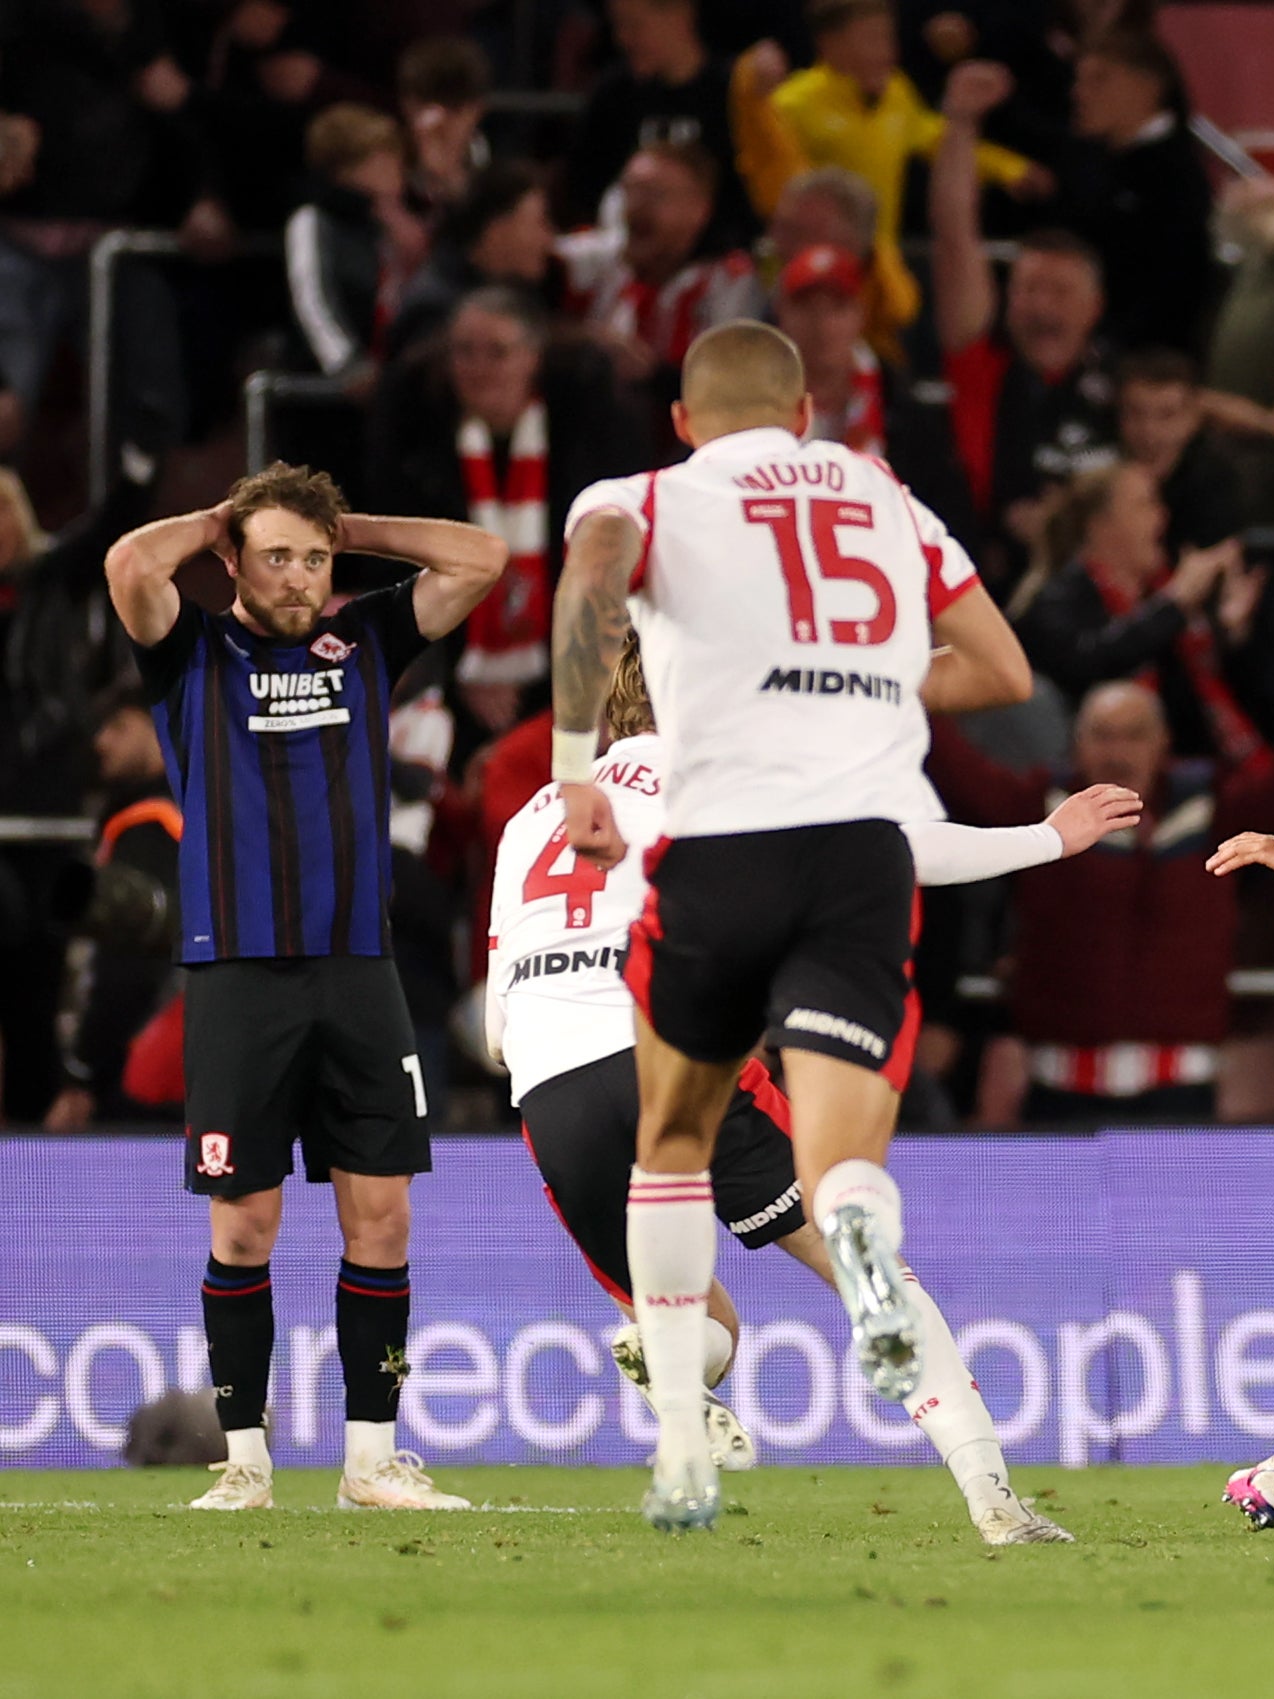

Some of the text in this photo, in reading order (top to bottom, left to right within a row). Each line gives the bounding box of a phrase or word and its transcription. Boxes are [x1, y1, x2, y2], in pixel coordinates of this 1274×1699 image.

[742, 496, 896, 645] 15
[250, 668, 344, 699] UNIBET
[522, 814, 609, 929] 4
[508, 946, 630, 990] MIDNIT
